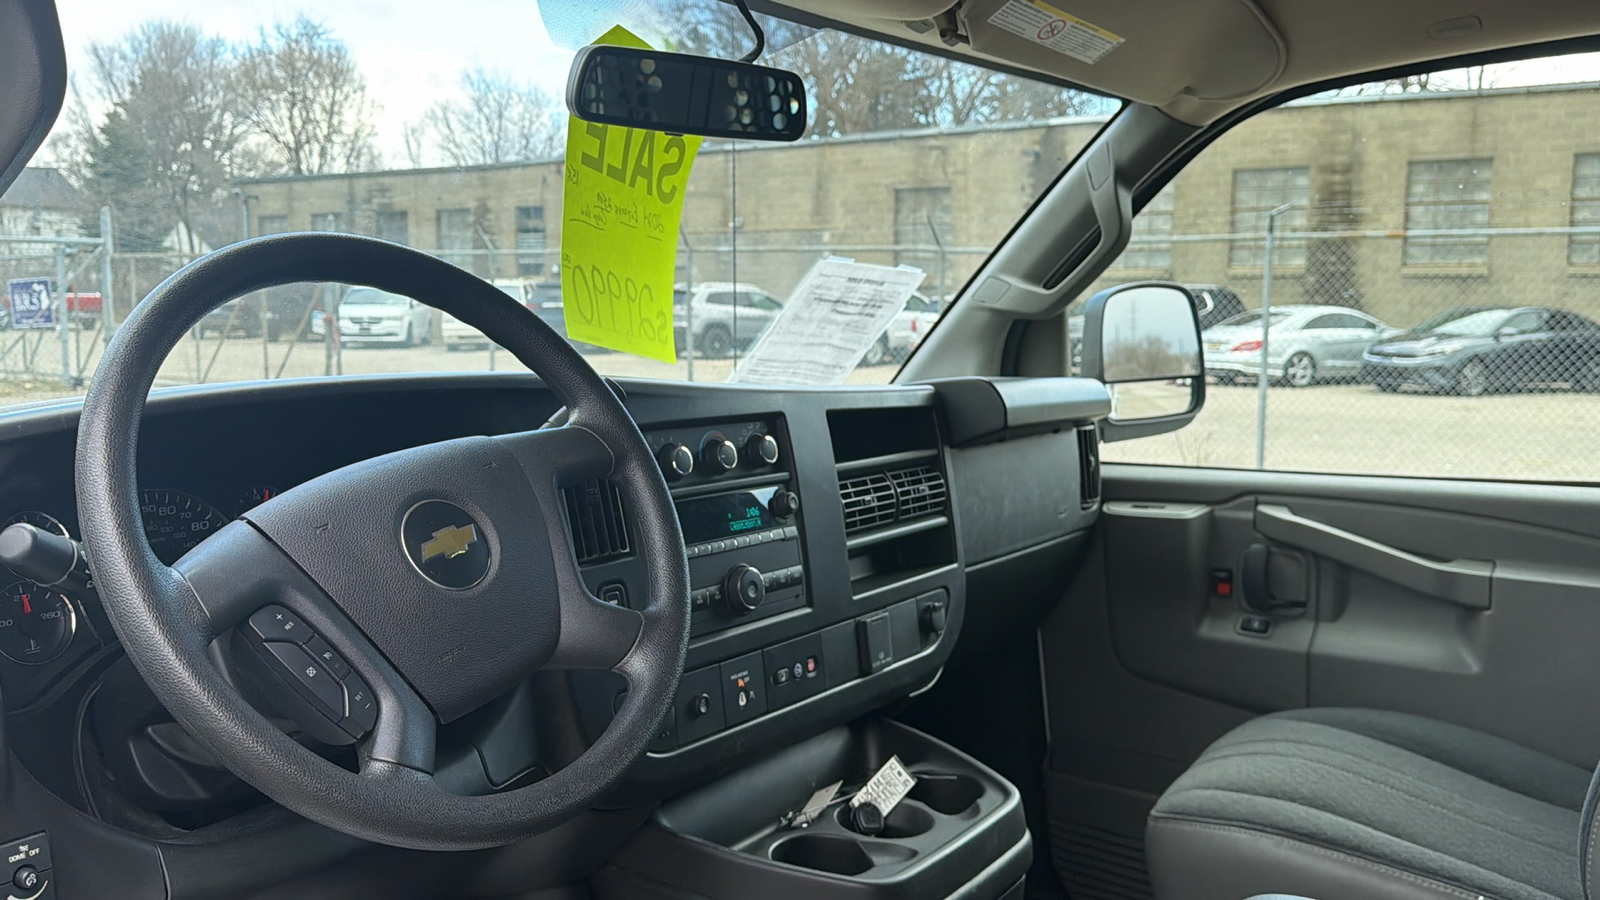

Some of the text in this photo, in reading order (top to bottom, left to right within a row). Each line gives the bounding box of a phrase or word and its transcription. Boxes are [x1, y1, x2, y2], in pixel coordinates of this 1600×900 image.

[159, 505, 177, 516] 60
[179, 511, 192, 519] 70
[191, 521, 209, 531] 80
[40, 611, 61, 620] 260
[9, 847, 40, 863] DOME OFF
